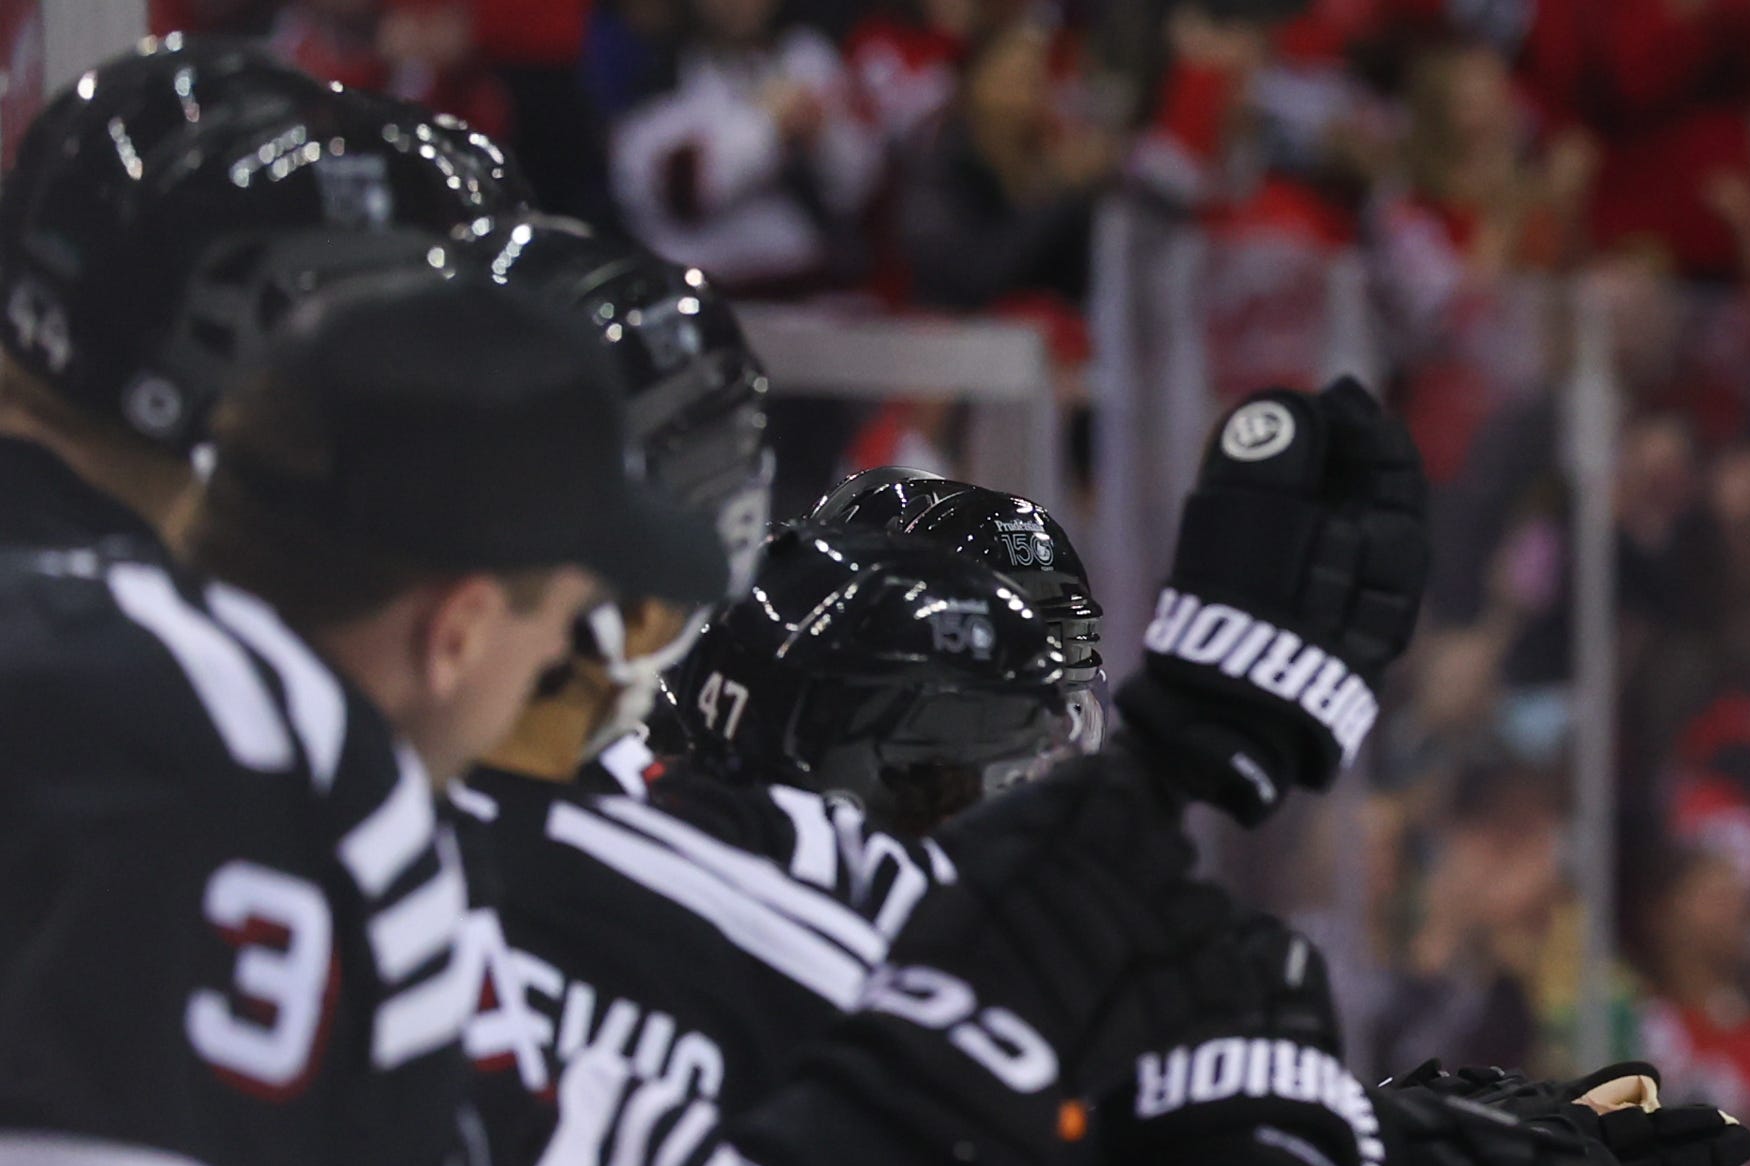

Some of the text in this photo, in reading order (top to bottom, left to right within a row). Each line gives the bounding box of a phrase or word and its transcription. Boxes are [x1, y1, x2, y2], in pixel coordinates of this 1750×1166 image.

[1001, 533, 1054, 566] 150
[698, 671, 749, 740] 47
[1144, 586, 1379, 768] RRIOR
[185, 858, 340, 1098] 3
